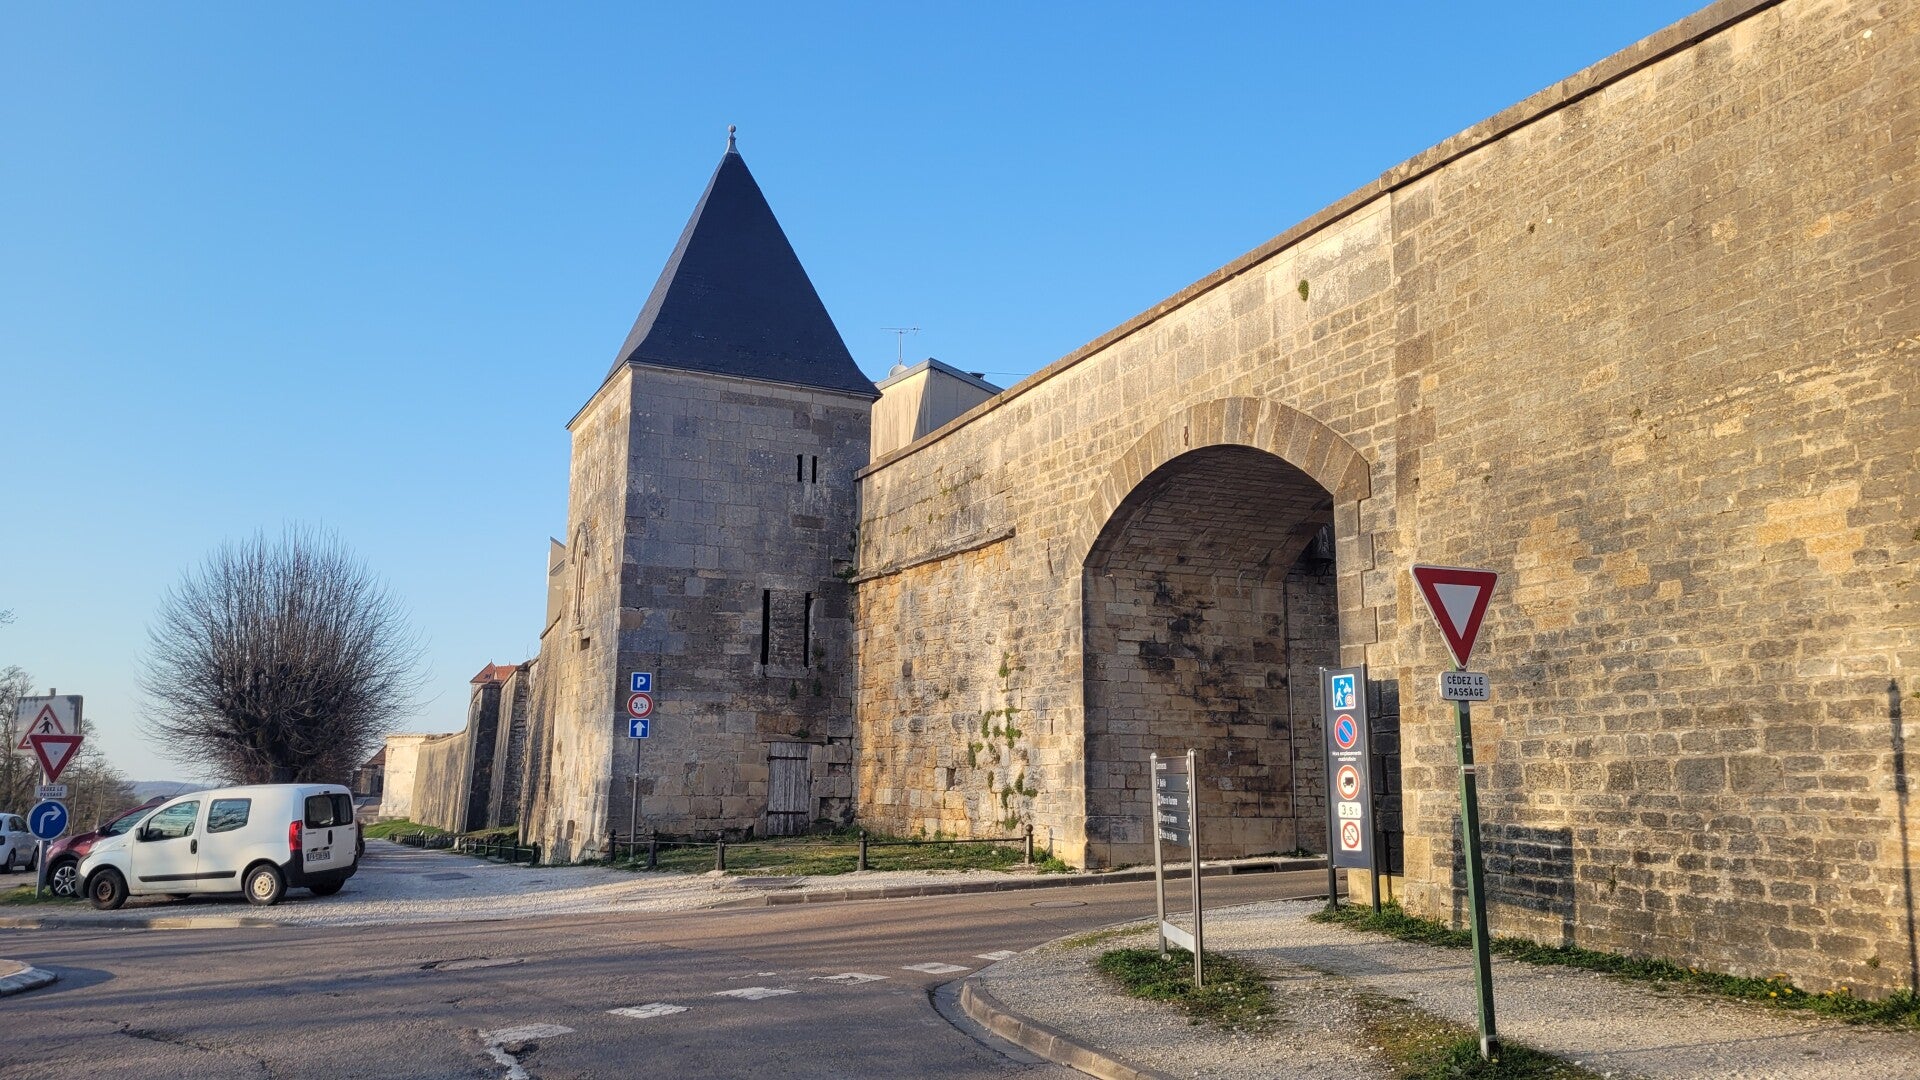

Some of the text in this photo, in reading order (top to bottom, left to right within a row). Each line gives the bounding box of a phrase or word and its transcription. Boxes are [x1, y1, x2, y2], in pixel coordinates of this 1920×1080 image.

[636, 676, 646, 688] P
[1447, 674, 1484, 685] CÉDEZ LE
[1448, 687, 1484, 696] PASSAGE
